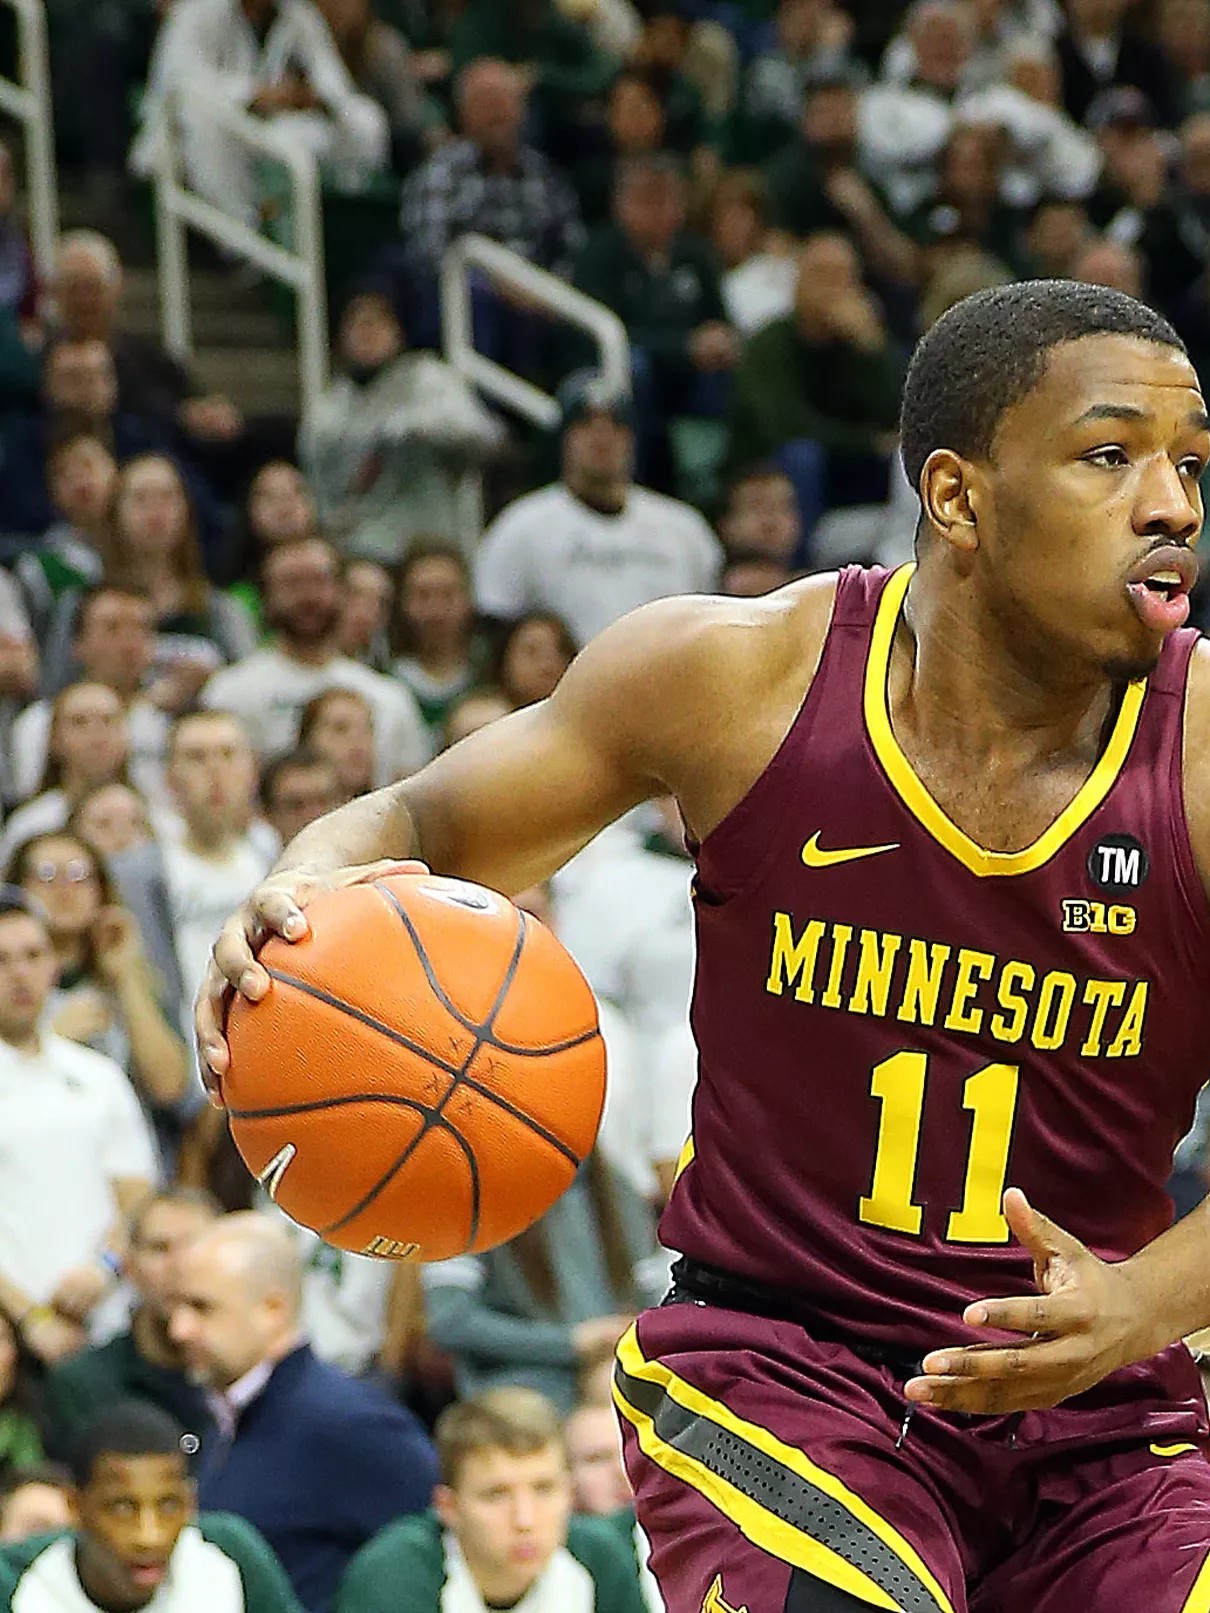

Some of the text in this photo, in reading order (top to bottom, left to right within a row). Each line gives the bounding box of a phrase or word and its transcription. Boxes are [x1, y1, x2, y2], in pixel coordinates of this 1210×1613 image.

[1099, 846, 1140, 885] TM
[766, 911, 1149, 1058] MINNESOTA
[859, 1050, 1021, 1244] 11
